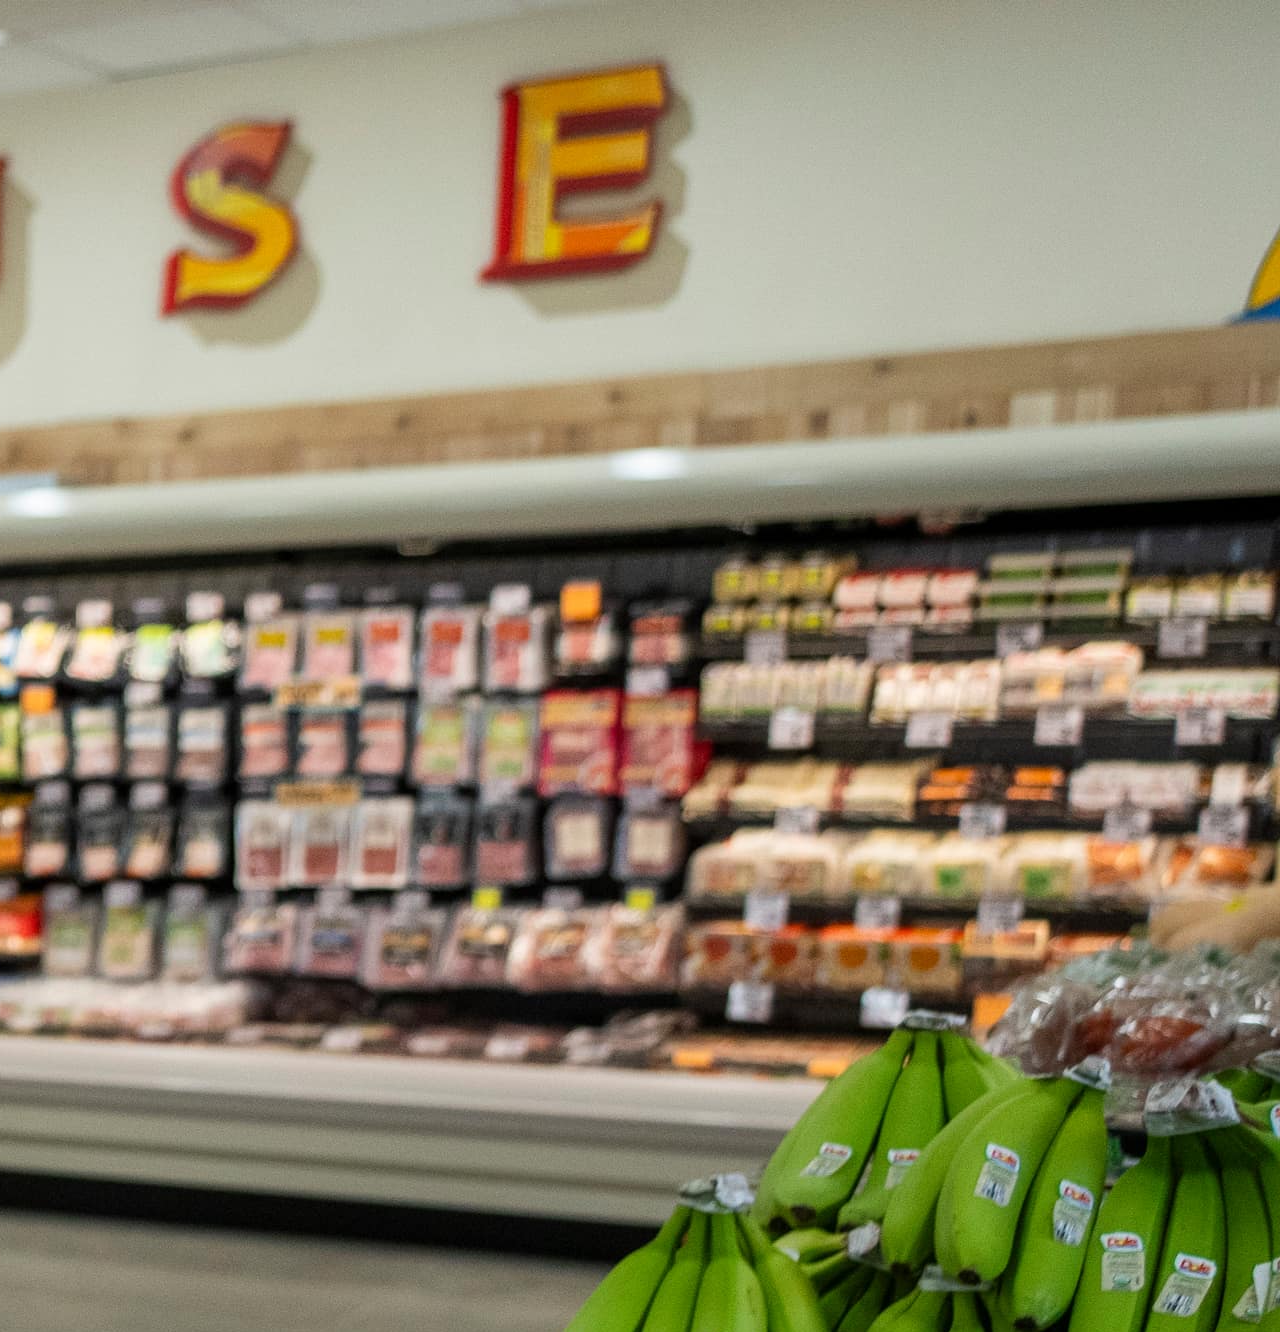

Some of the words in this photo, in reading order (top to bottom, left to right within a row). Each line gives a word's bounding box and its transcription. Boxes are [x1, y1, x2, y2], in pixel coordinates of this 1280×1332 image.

[1064, 1186, 1091, 1204] Dole
[1106, 1236, 1138, 1247] Dole
[1179, 1259, 1211, 1275] Dole
